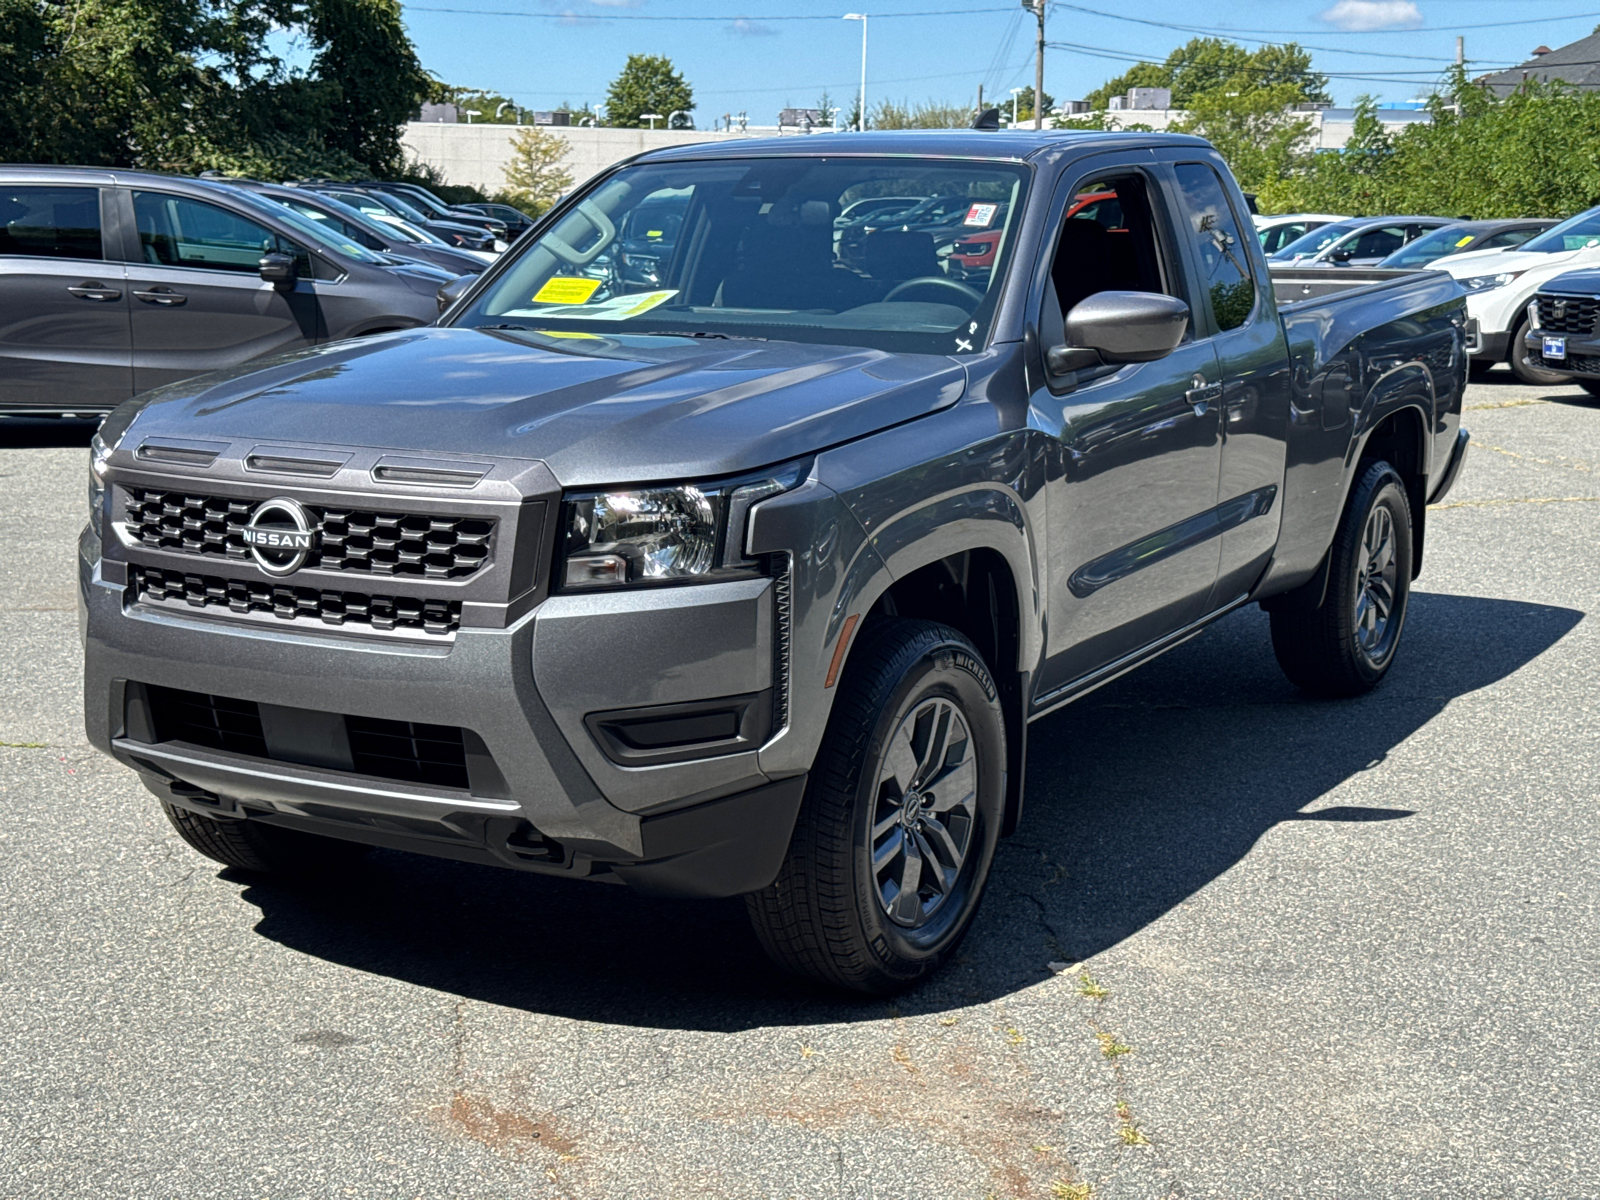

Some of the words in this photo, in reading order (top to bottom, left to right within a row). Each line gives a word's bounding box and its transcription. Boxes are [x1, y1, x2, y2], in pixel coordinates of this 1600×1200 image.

[243, 529, 309, 547] NISSAN
[956, 652, 995, 699] MICHELIN
[858, 880, 873, 931] PRIMACY
